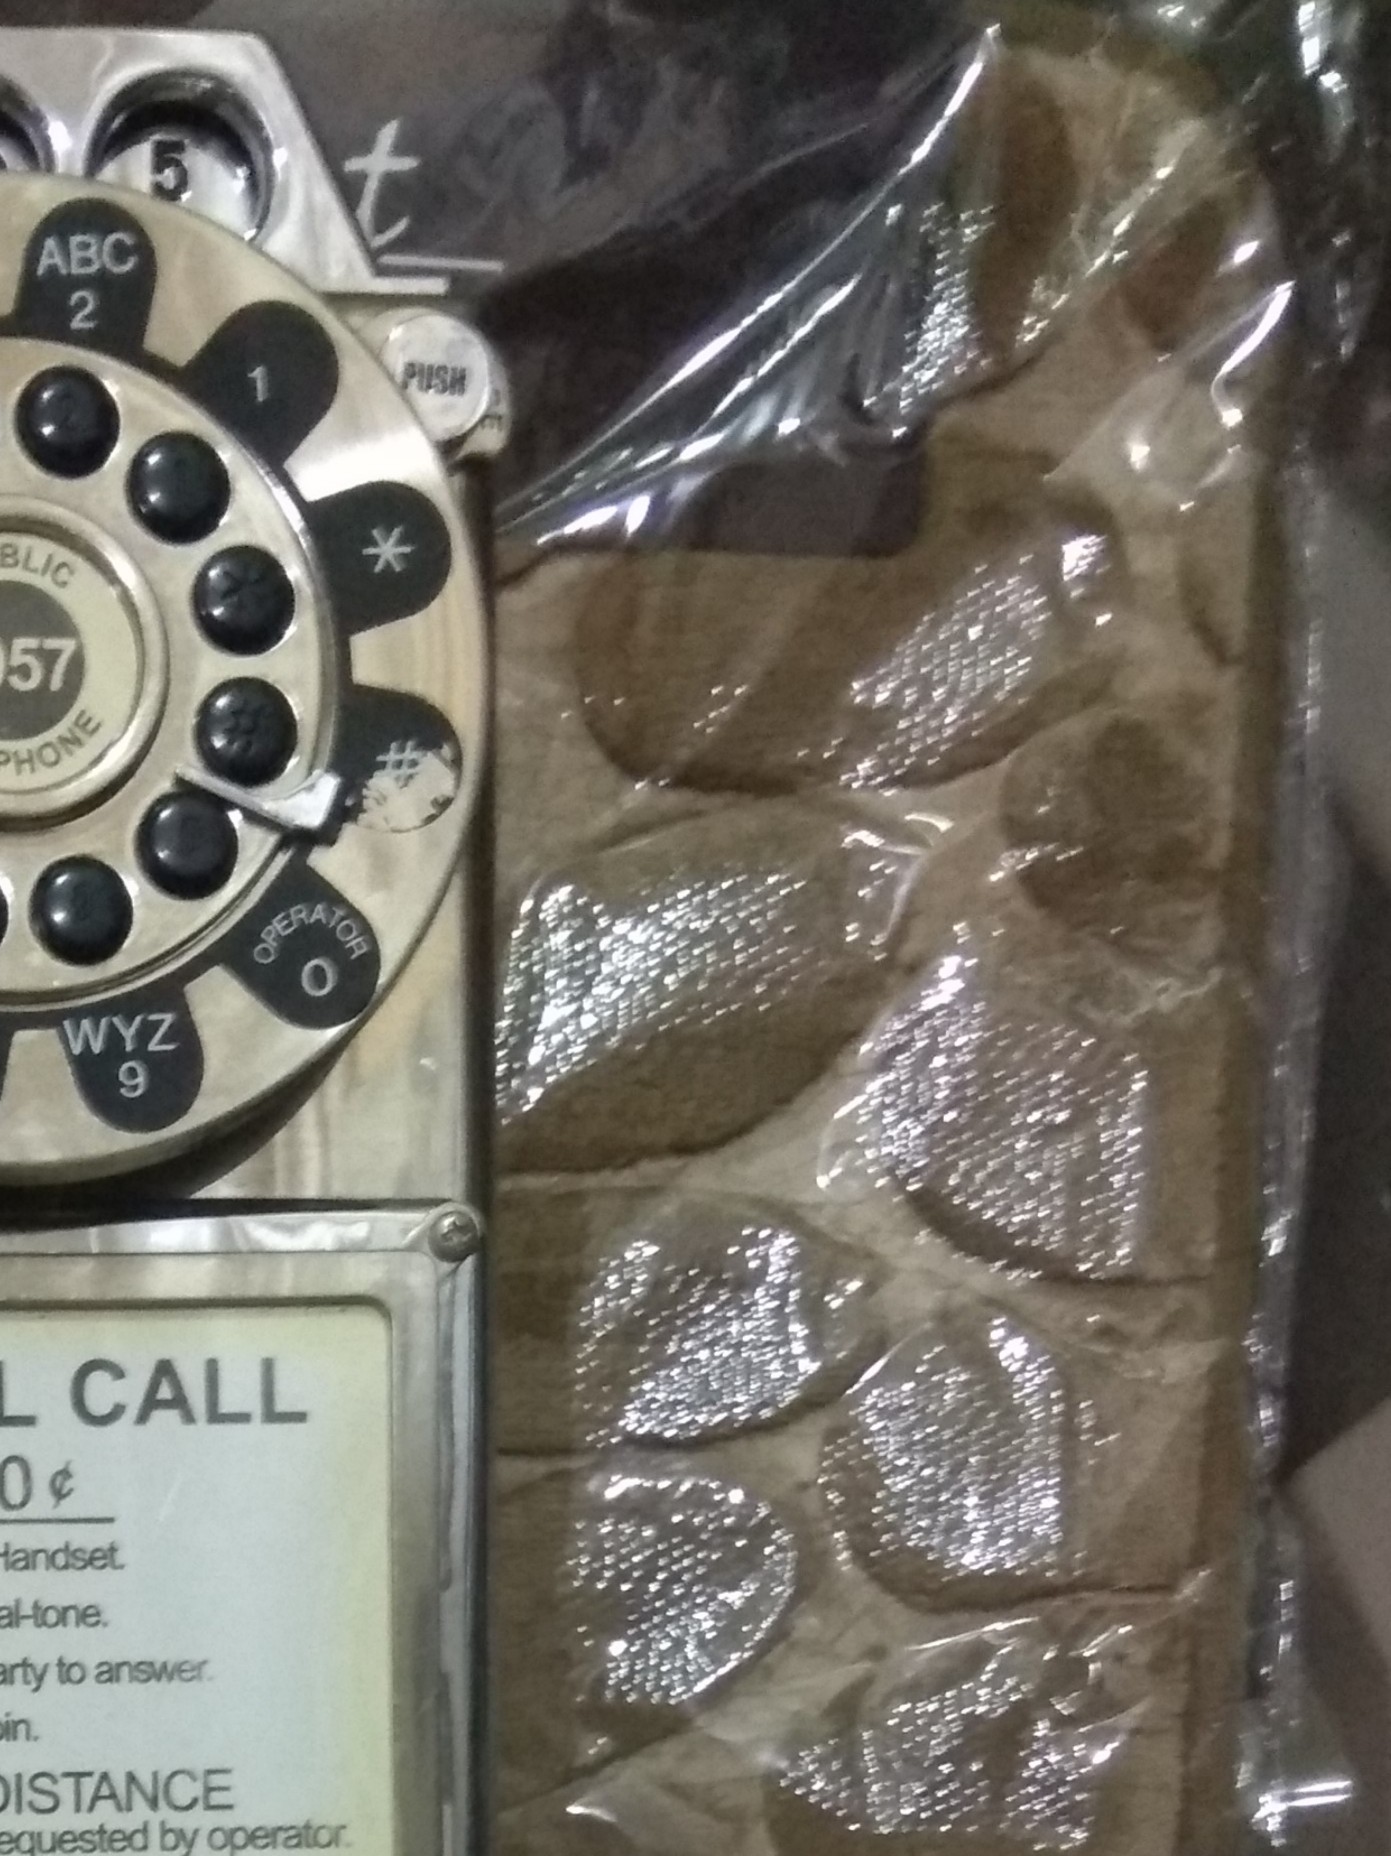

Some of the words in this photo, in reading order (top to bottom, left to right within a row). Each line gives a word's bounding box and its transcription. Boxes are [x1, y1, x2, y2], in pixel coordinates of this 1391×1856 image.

[151, 138, 191, 200] 5
[37, 232, 139, 276] ABC
[69, 291, 97, 331] 2
[247, 366, 270, 402] 1
[402, 362, 466, 397] PUSH
[254, 902, 369, 964] OPERATOR
[63, 1012, 179, 1055] WYZ
[118, 1060, 149, 1098] 9
[69, 1356, 308, 1427] CALL
[57, 1656, 86, 1685] to
